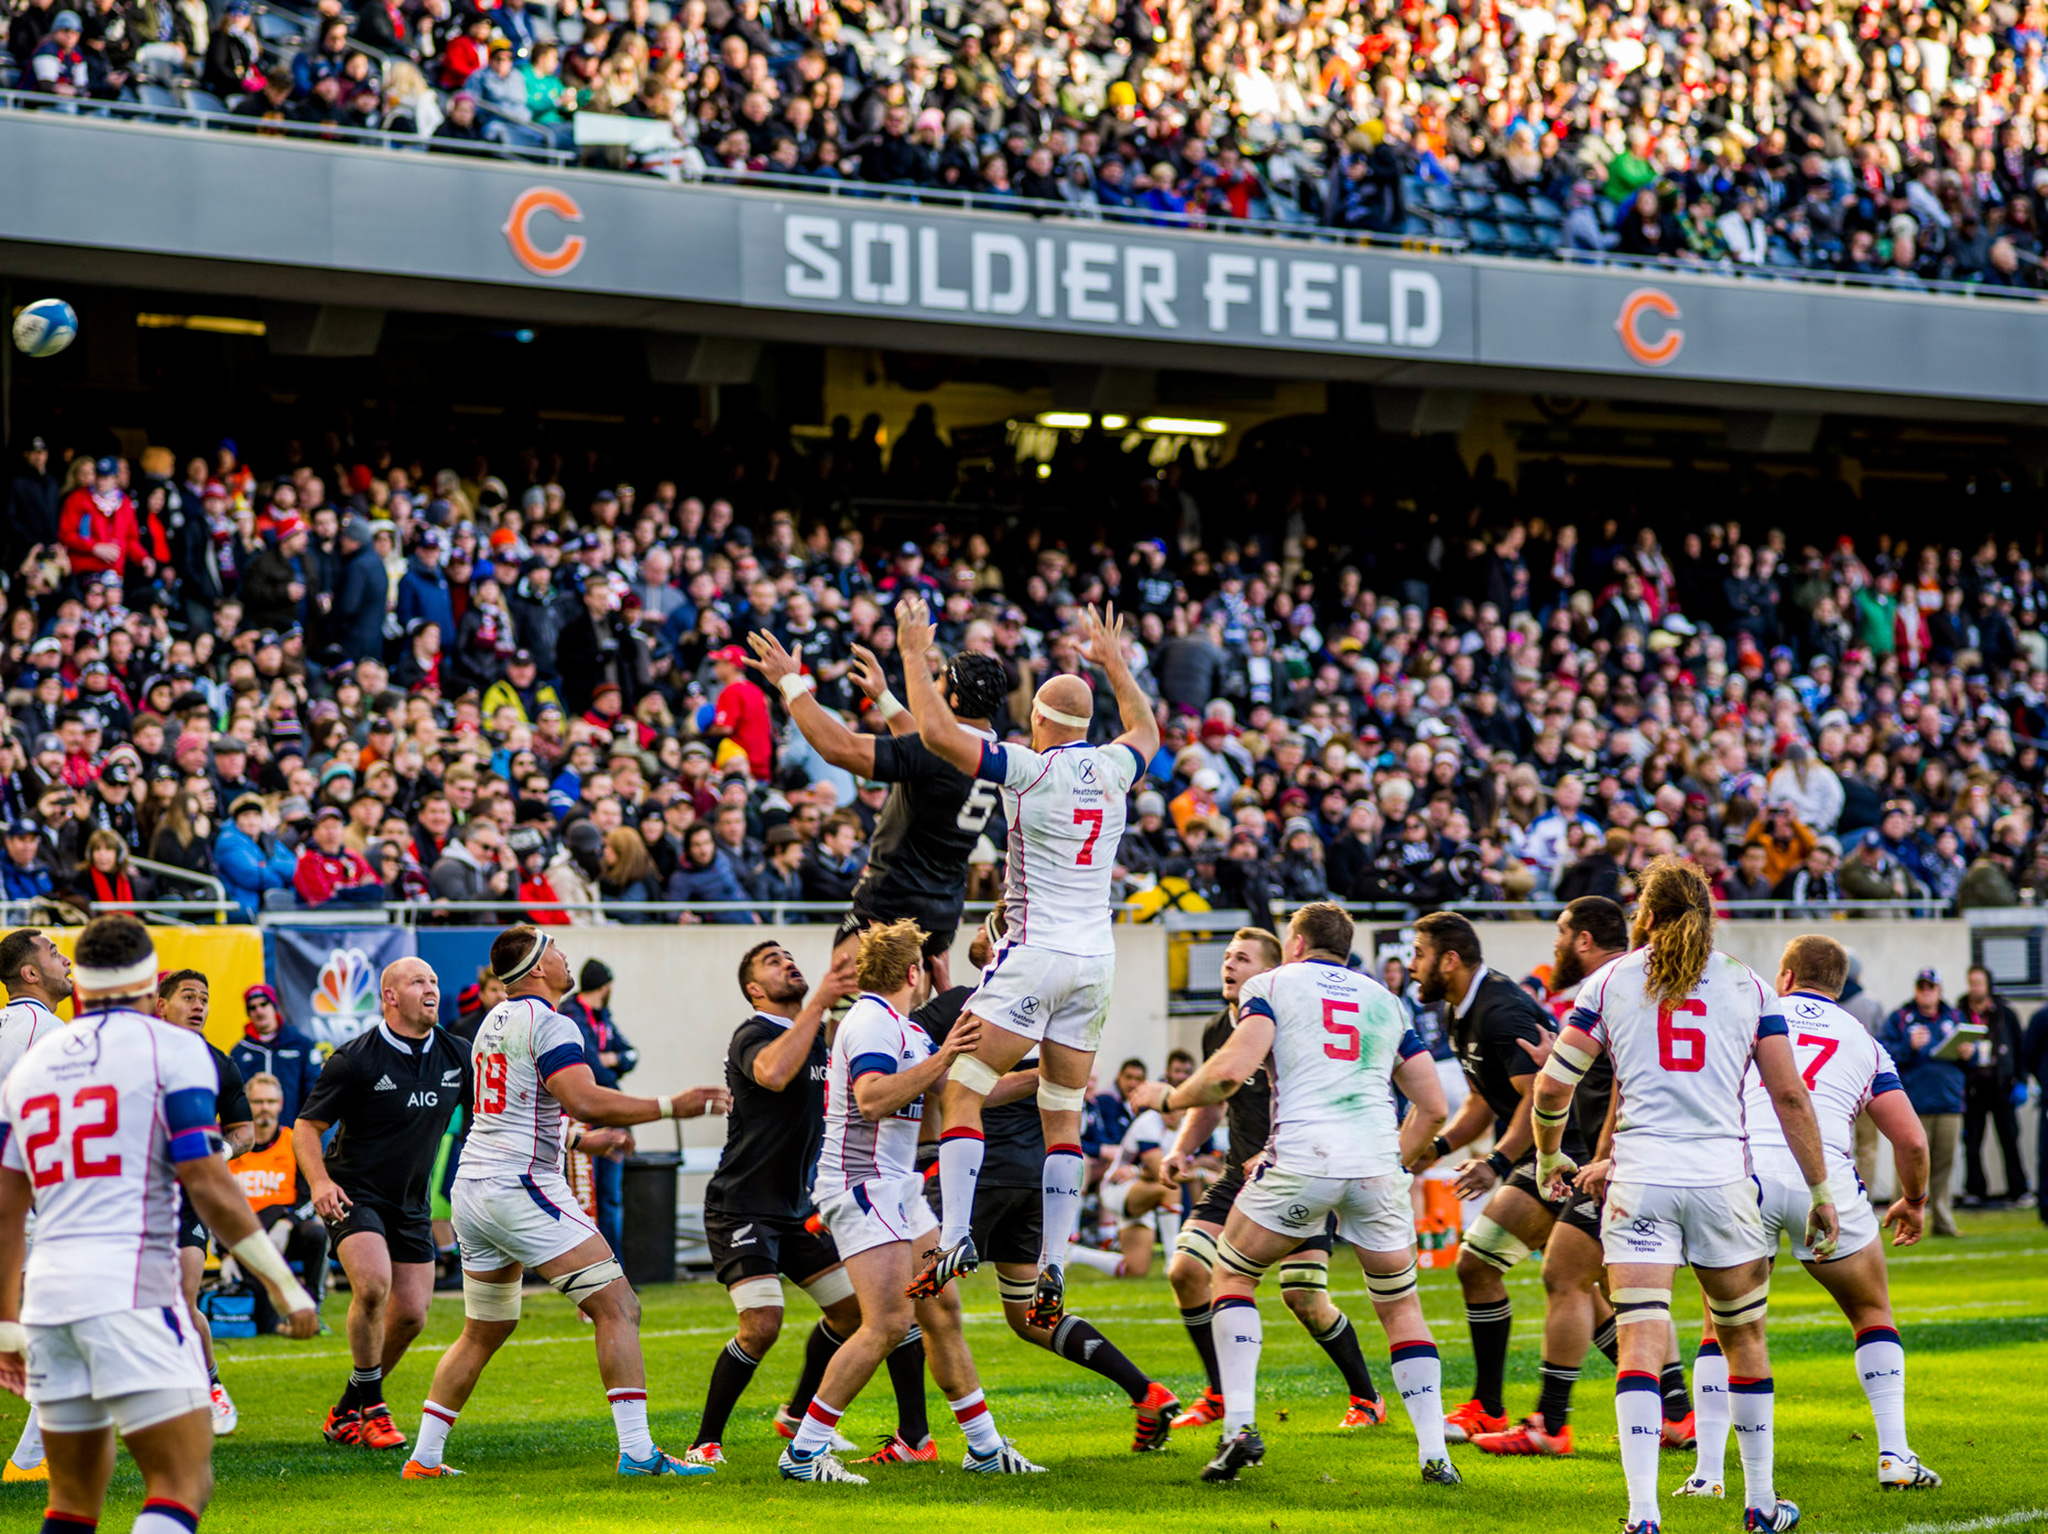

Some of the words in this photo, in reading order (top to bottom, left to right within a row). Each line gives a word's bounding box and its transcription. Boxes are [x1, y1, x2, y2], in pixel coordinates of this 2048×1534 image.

[503, 186, 586, 276] C
[785, 215, 1179, 328] SOLDIER
[1204, 254, 1442, 348] FIELD
[1614, 287, 1684, 367] C
[1072, 787, 1104, 796] Heathrow
[957, 778, 998, 833] 6
[1073, 809, 1103, 866] 7
[1008, 1009, 1036, 1024] Heathrow
[1321, 998, 1361, 1062] 5
[1657, 998, 1707, 1072] 6
[473, 1052, 509, 1115] 19
[407, 1091, 438, 1107] AIG
[21, 1085, 121, 1189] 22
[1045, 1186, 1078, 1197] BLK
[1627, 1239, 1662, 1247] Heathrow
[1235, 1335, 1262, 1344] BL
[1863, 1368, 1901, 1381] BLK
[1402, 1385, 1434, 1400] BLK
[1702, 1385, 1727, 1393] BL
[1631, 1426, 1662, 1437] BLK
[1734, 1423, 1767, 1432] BLK
